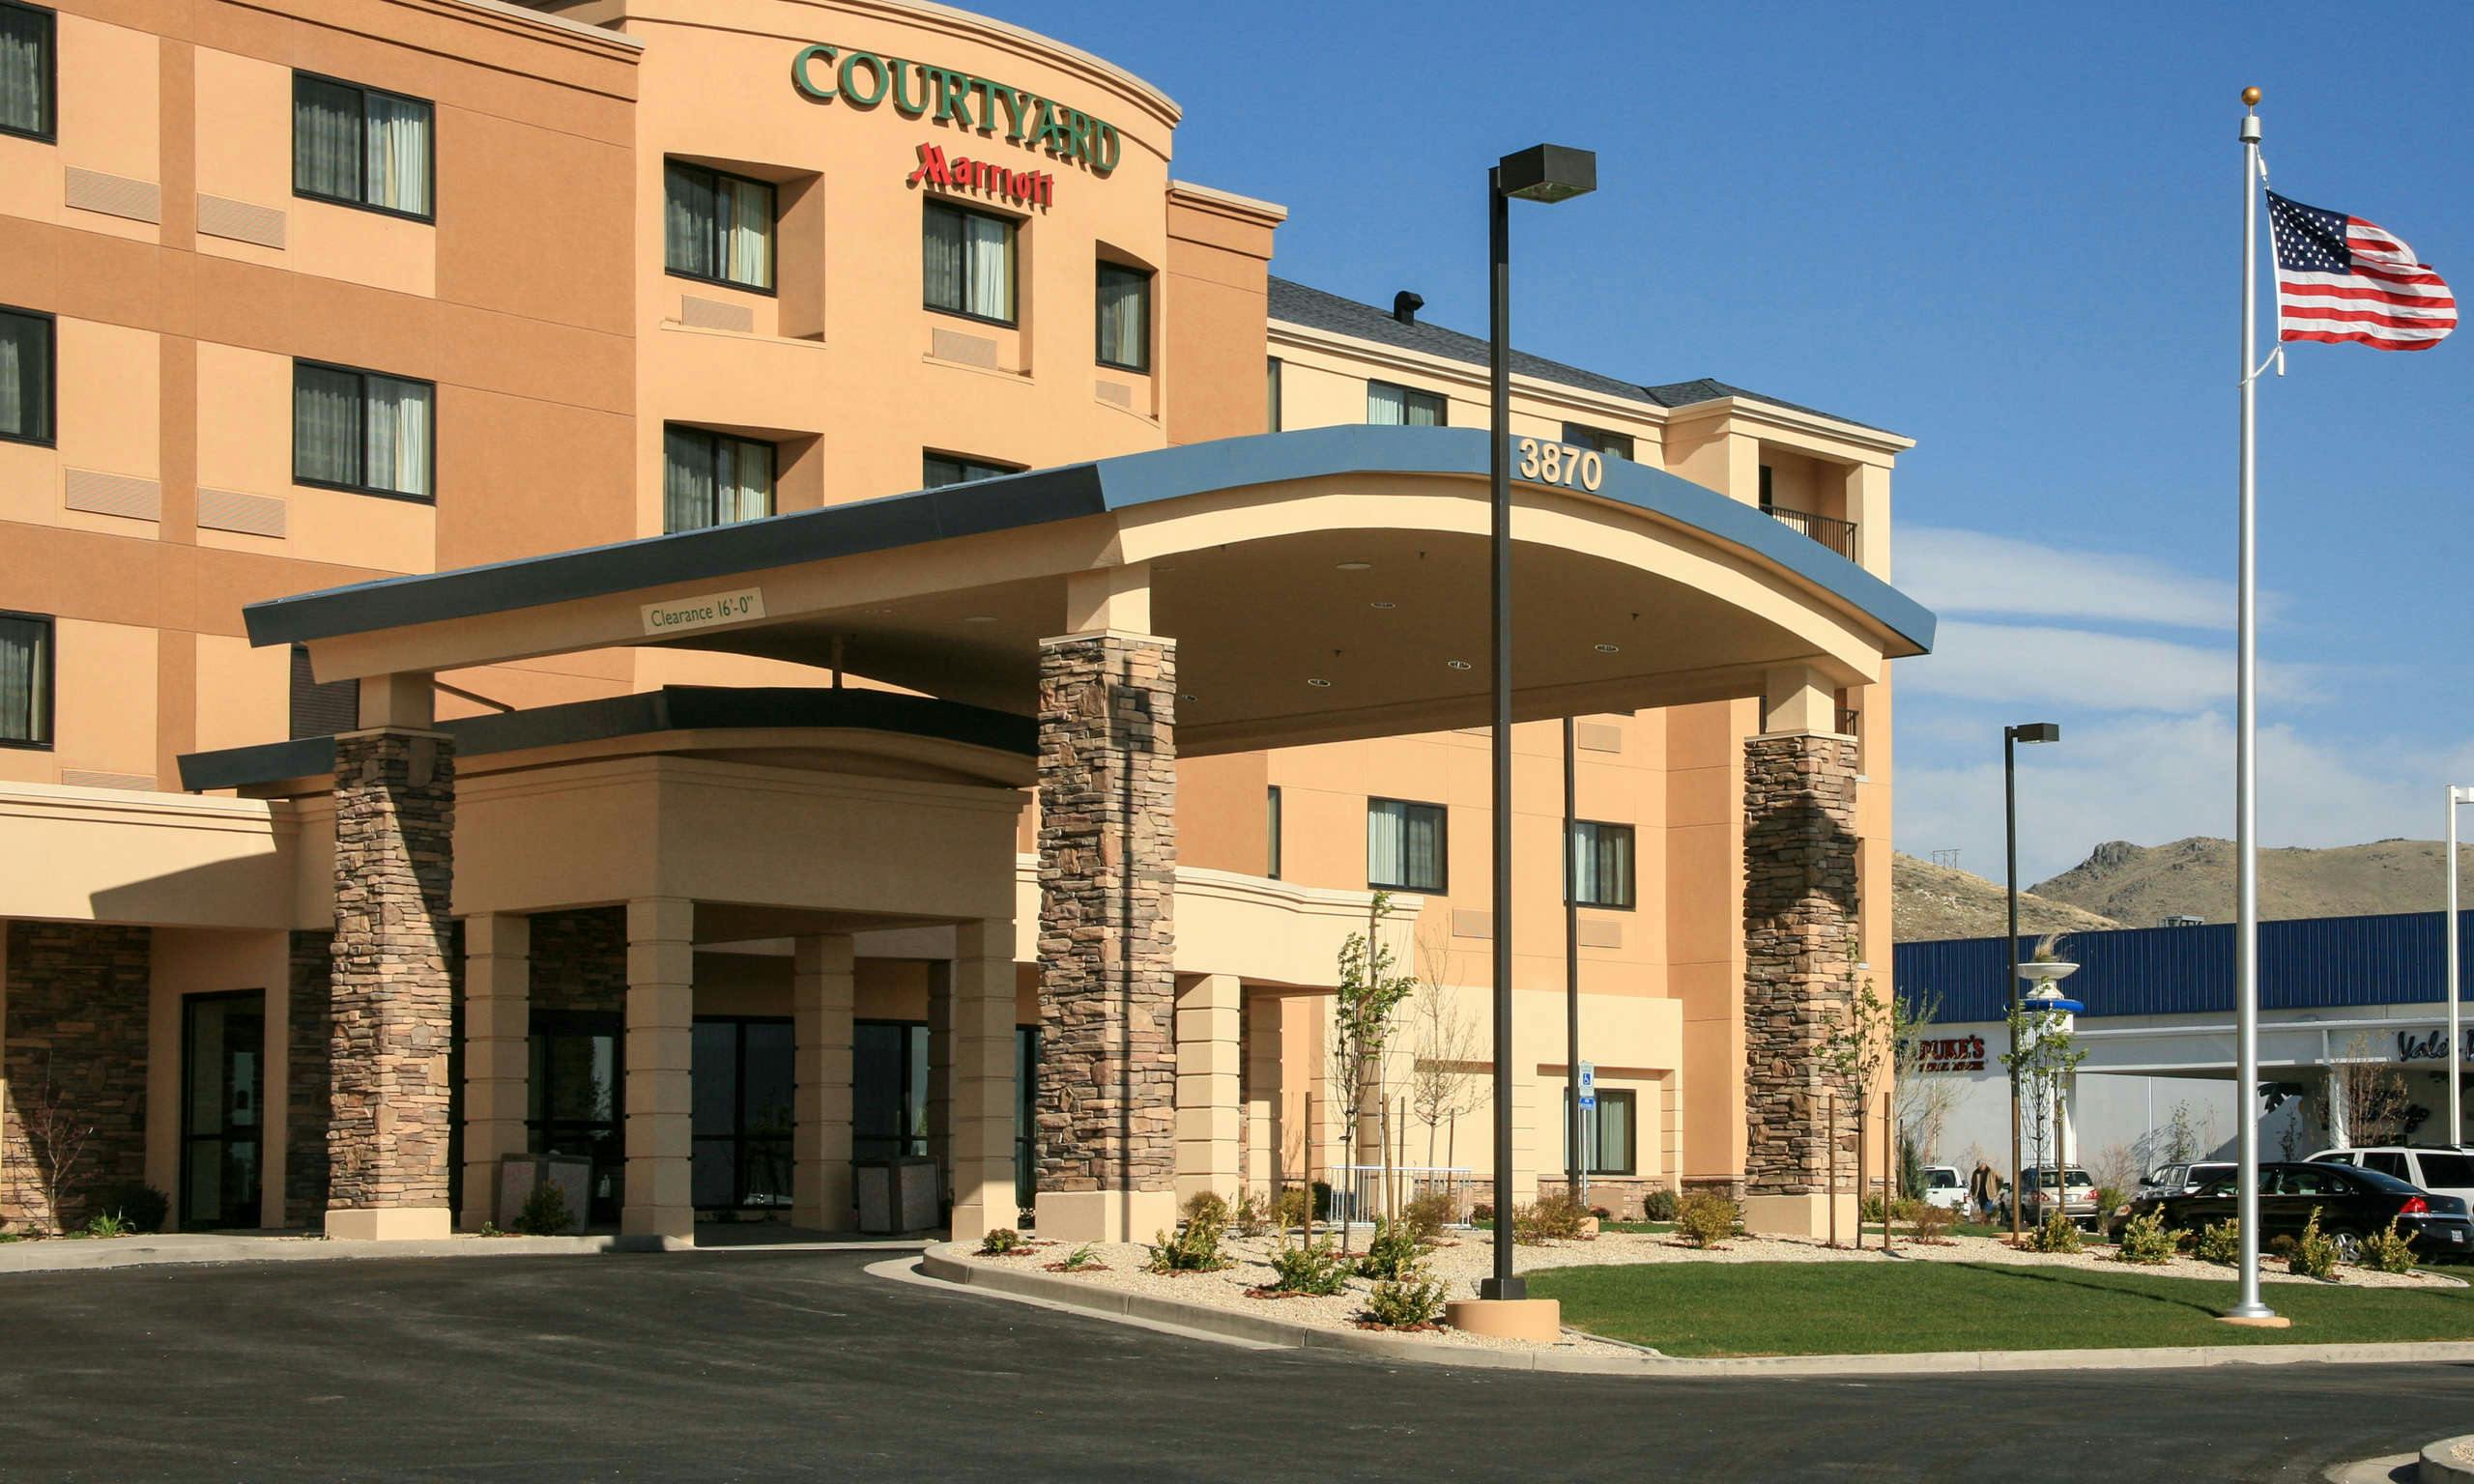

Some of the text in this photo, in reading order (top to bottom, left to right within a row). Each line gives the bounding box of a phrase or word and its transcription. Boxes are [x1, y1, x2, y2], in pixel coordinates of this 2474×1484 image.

[791, 43, 1121, 177] COURTYARD
[906, 142, 1054, 212] Marriott
[1519, 438, 1602, 492] 3870
[650, 607, 713, 627] Clearance
[2398, 1030, 2461, 1062] Vale
